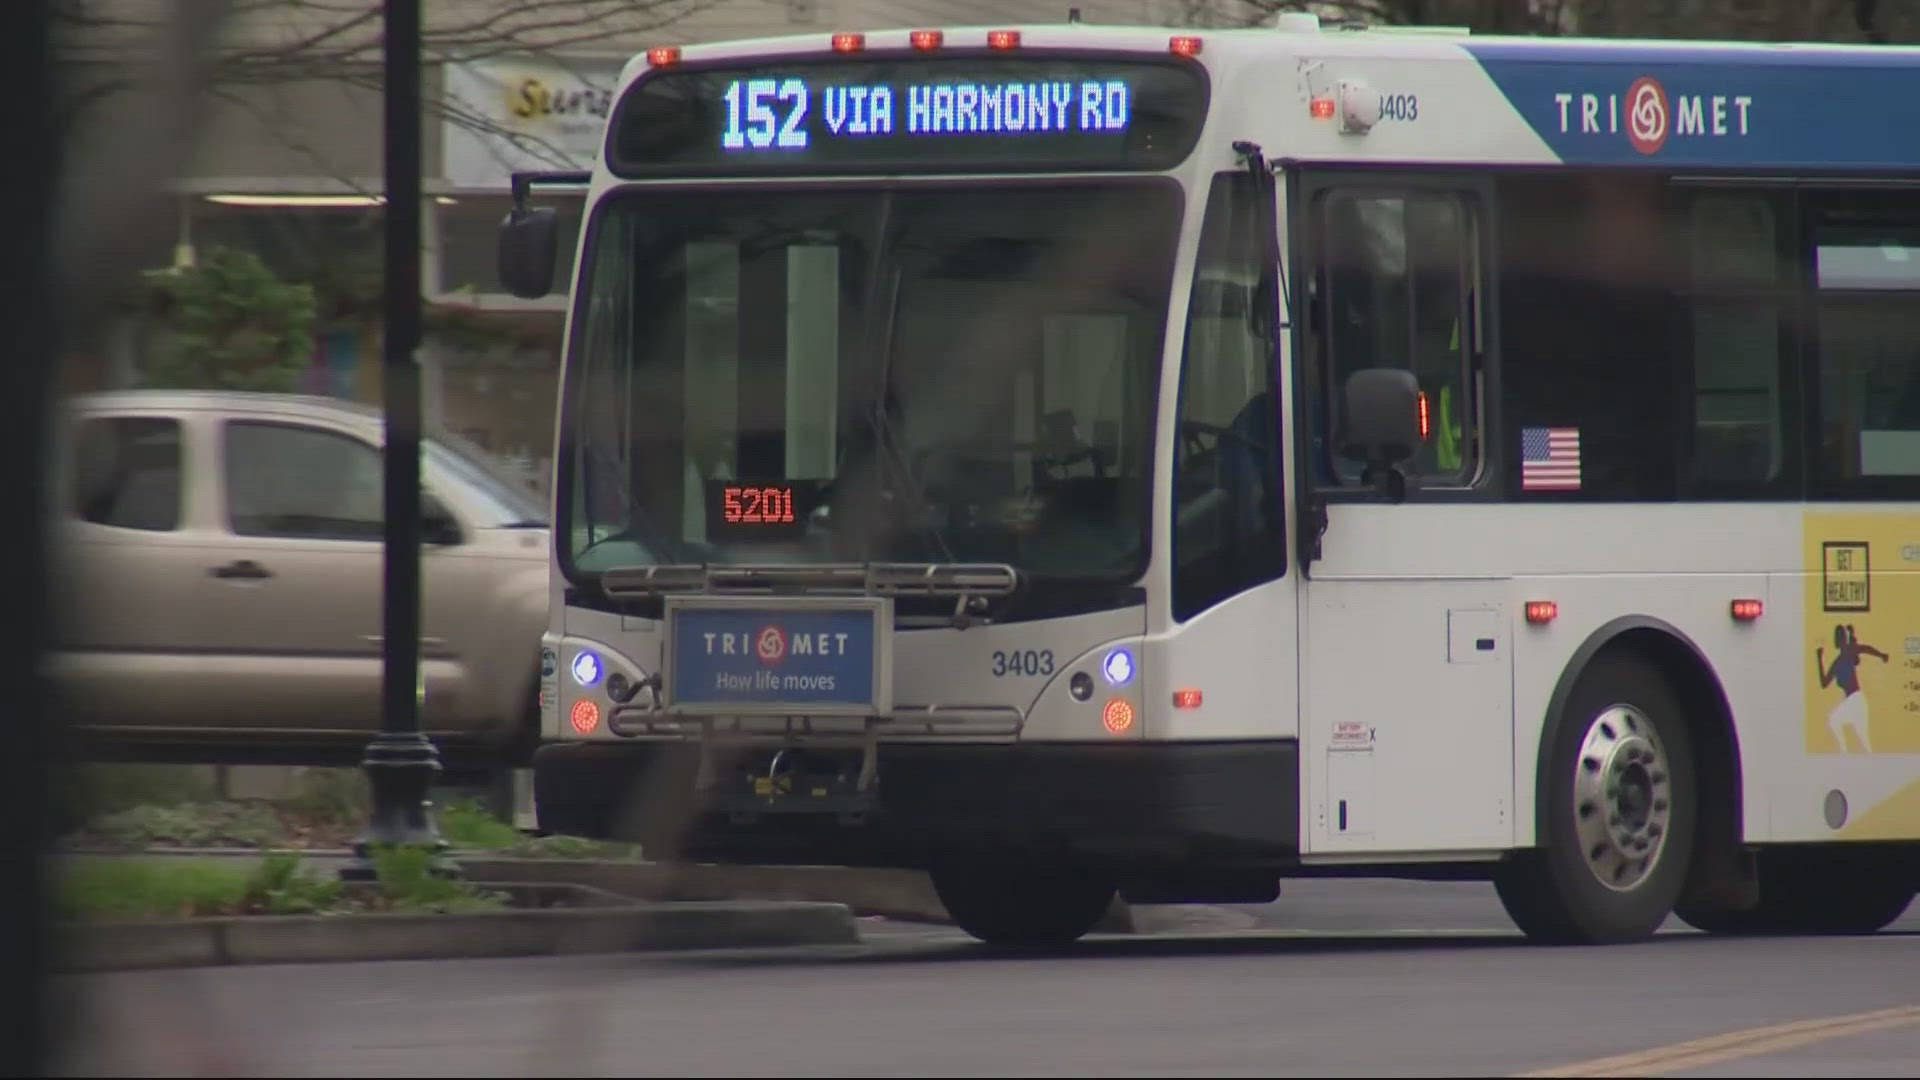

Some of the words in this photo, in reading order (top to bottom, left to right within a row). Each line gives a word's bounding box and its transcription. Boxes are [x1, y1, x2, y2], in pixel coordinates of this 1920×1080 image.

[722, 79, 808, 149] 152
[824, 86, 892, 134] VIA
[908, 83, 1072, 133] HARMONY
[1080, 81, 1129, 130] RD
[1555, 93, 1618, 134] TRI
[1676, 96, 1752, 135] MET
[724, 486, 795, 523] 5201
[1837, 549, 1854, 571] GET
[1828, 581, 1866, 602] HEALTHY
[703, 632, 749, 655] TRI
[792, 632, 849, 655] MET
[991, 650, 1055, 677] 3403
[716, 671, 752, 690] How
[755, 670, 780, 690] life
[784, 674, 836, 690] moves
